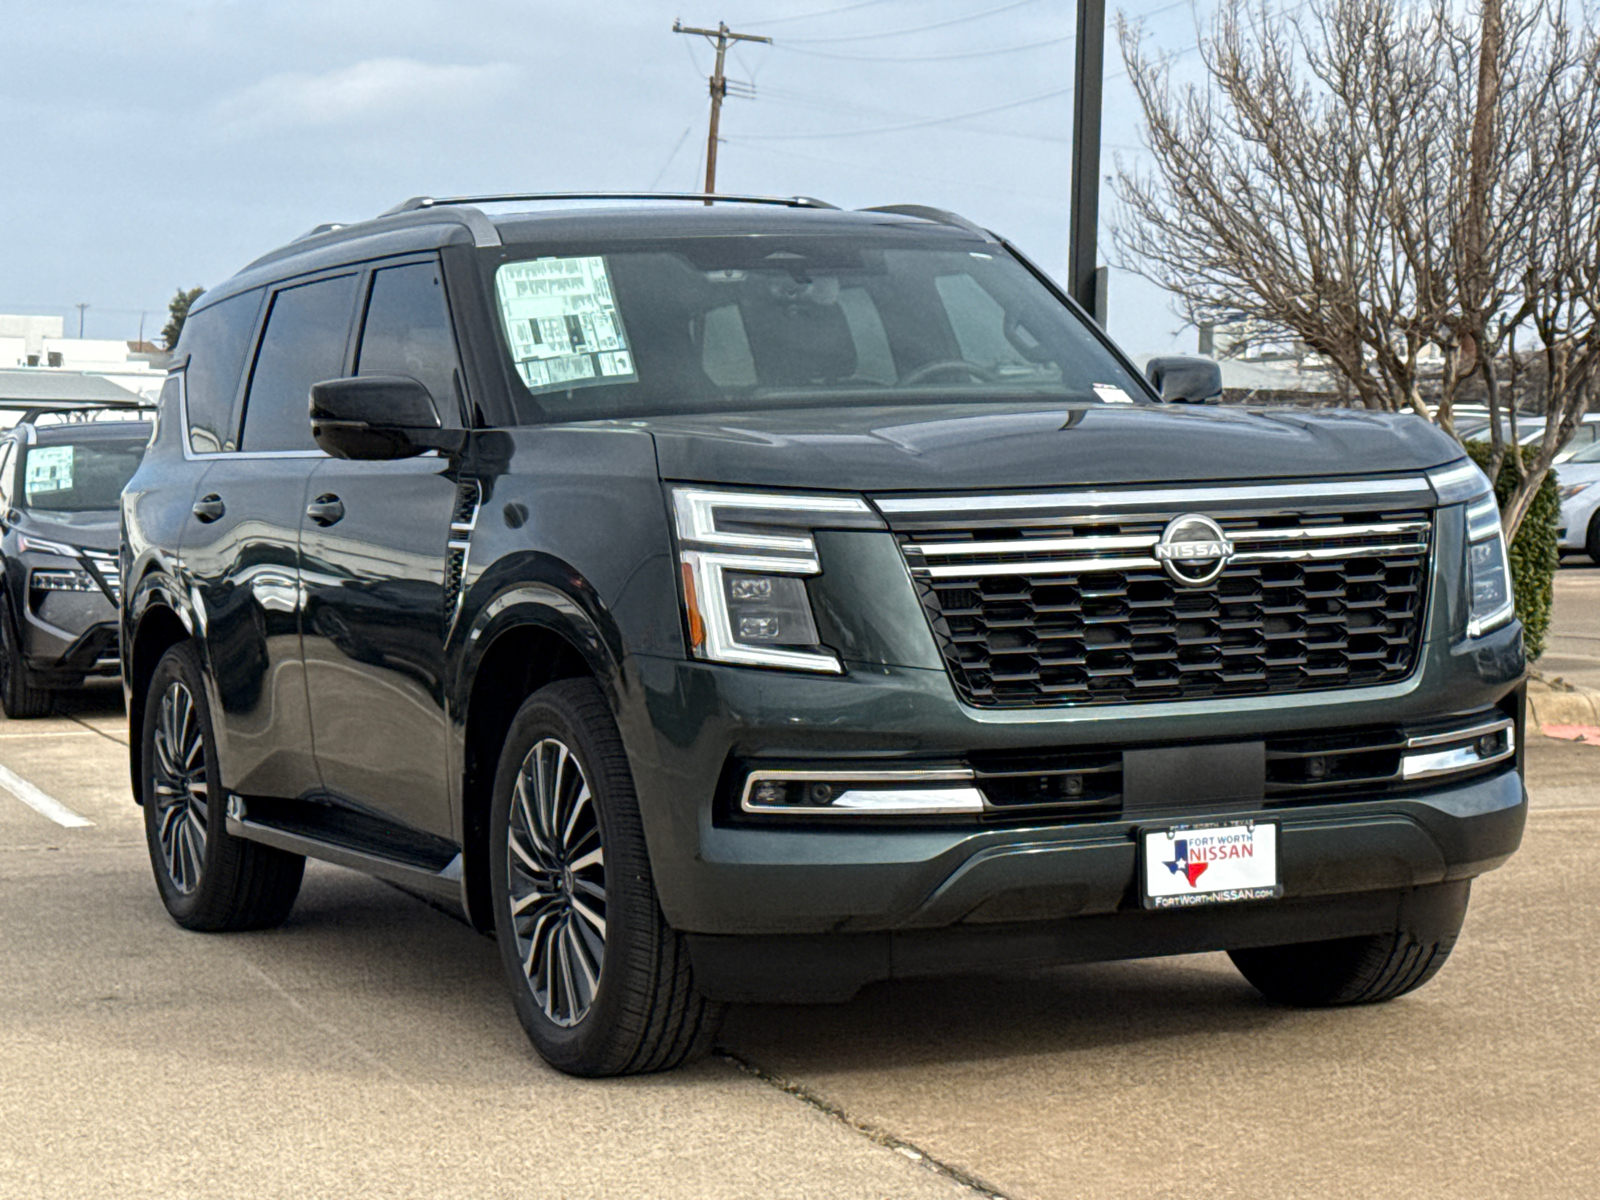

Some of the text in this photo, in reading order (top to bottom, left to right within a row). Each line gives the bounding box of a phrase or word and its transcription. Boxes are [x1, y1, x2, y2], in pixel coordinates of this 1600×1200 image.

[1157, 543, 1233, 558] NISSAN
[1189, 834, 1253, 847] FORT WORTH
[1189, 843, 1254, 862] NISSAN
